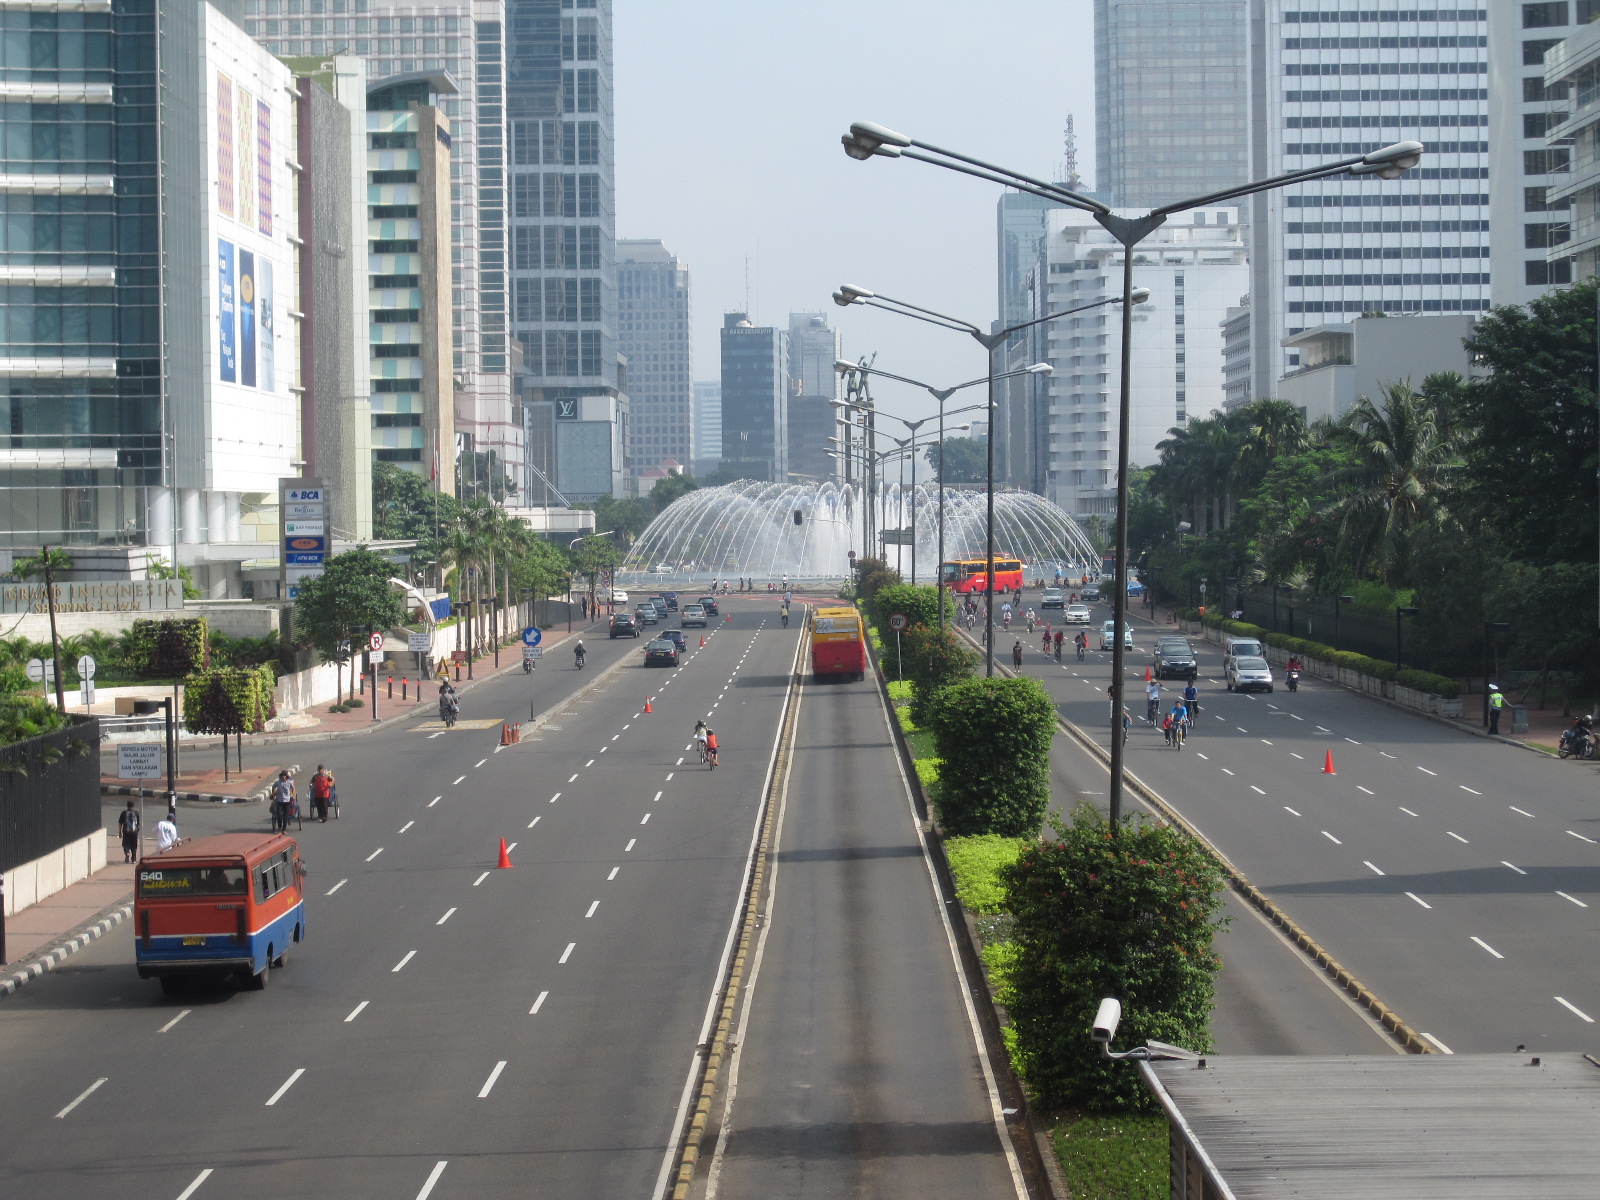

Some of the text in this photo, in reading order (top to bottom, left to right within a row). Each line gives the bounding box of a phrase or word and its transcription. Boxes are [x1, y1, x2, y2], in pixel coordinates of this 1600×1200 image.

[301, 491, 319, 500] BCA
[6, 582, 177, 600] GRAND INDONESIA
[35, 600, 141, 614] SHOPPING TOWN
[140, 871, 163, 881] 640
